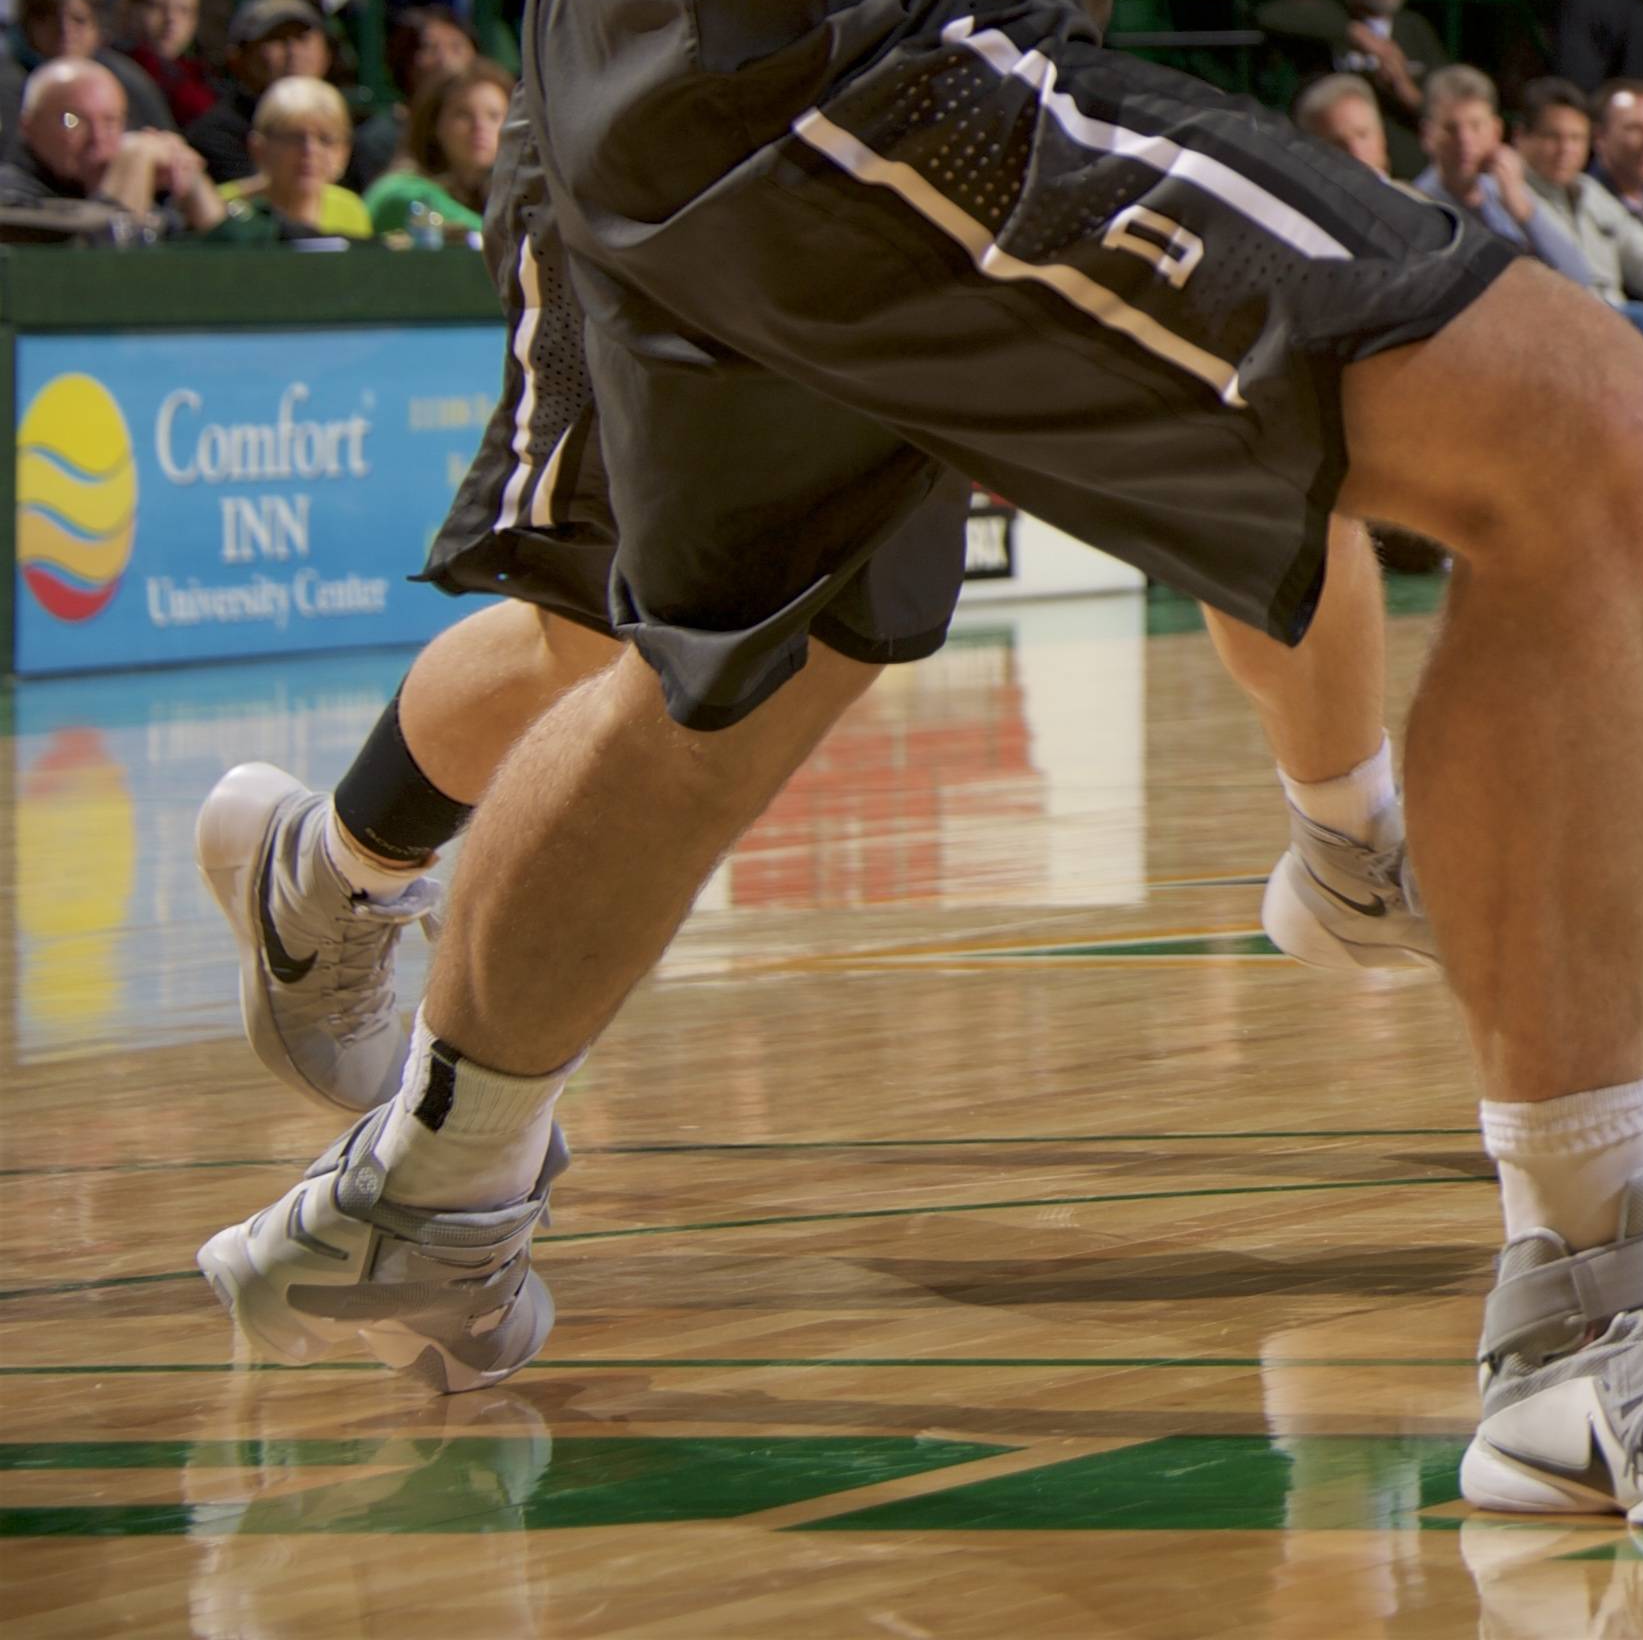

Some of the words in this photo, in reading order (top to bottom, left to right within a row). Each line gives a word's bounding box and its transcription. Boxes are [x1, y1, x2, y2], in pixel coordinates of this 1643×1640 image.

[155, 381, 372, 485] Comfort
[219, 492, 313, 563] INN
[145, 572, 288, 631] University
[292, 568, 390, 619] Center
